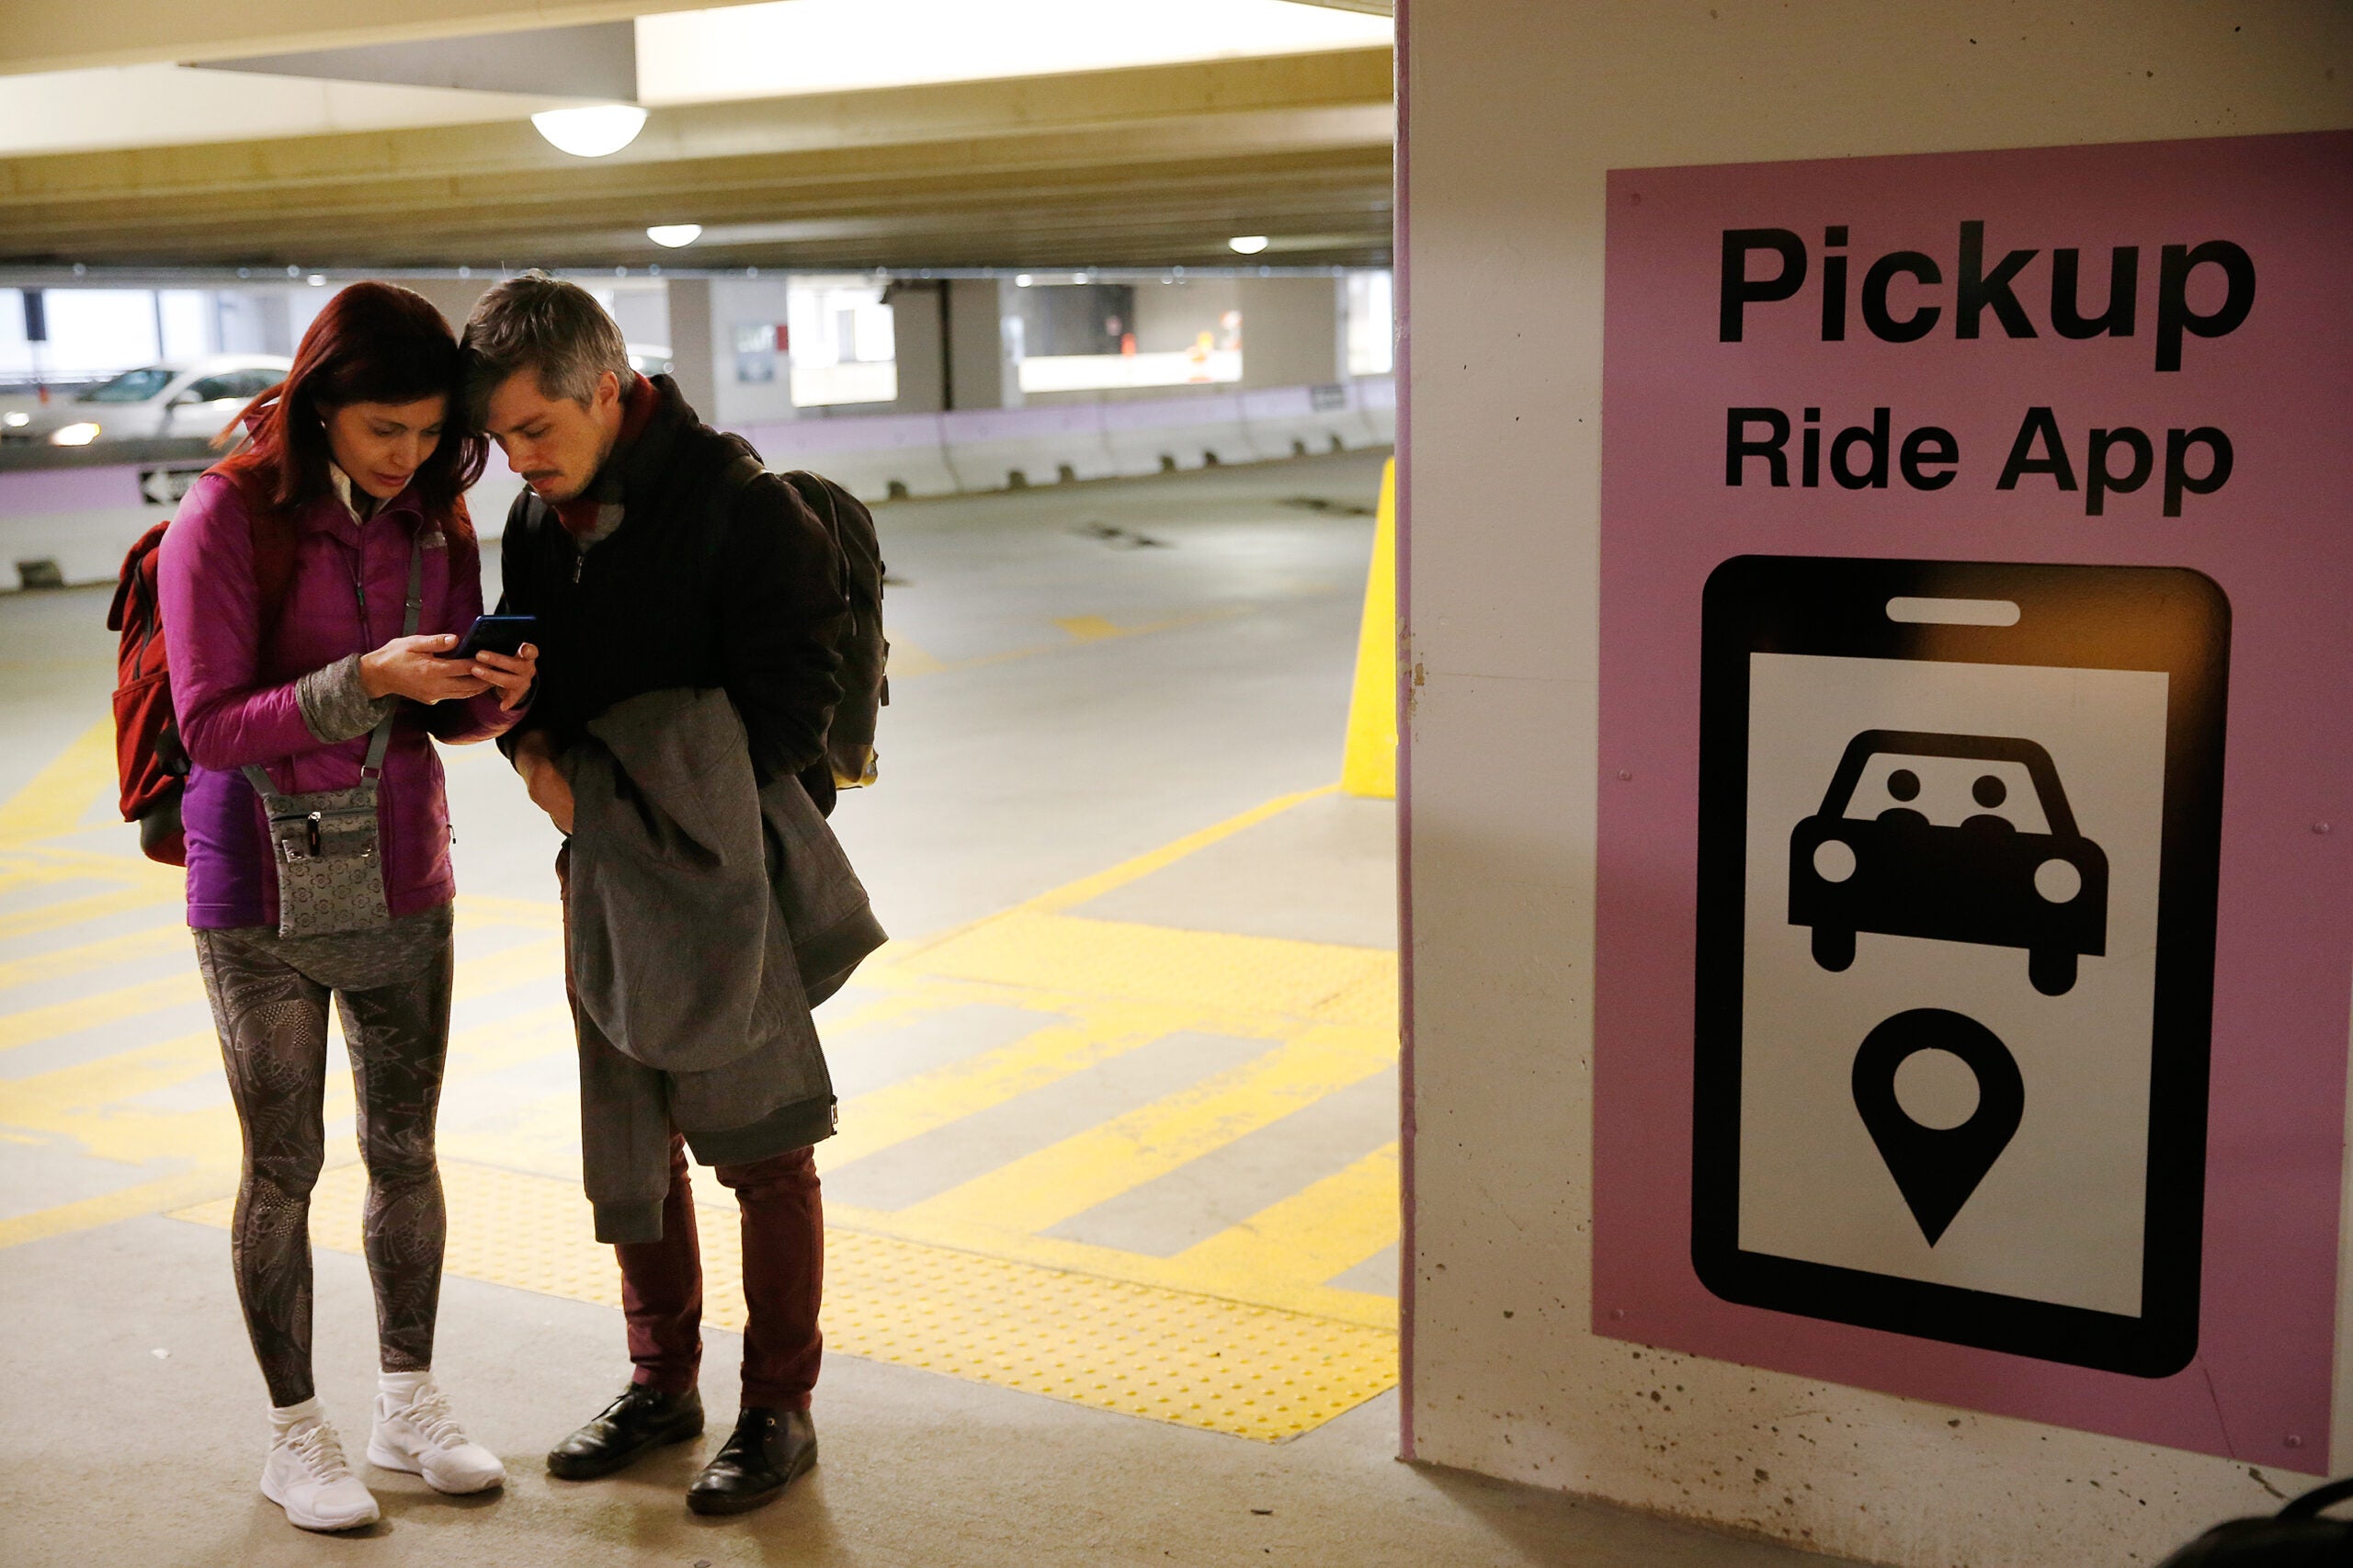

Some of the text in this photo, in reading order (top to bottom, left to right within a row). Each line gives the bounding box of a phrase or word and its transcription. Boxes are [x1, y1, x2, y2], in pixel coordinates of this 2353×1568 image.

[1719, 220, 2256, 372] Pickup
[1725, 406, 2234, 517] Ride App
